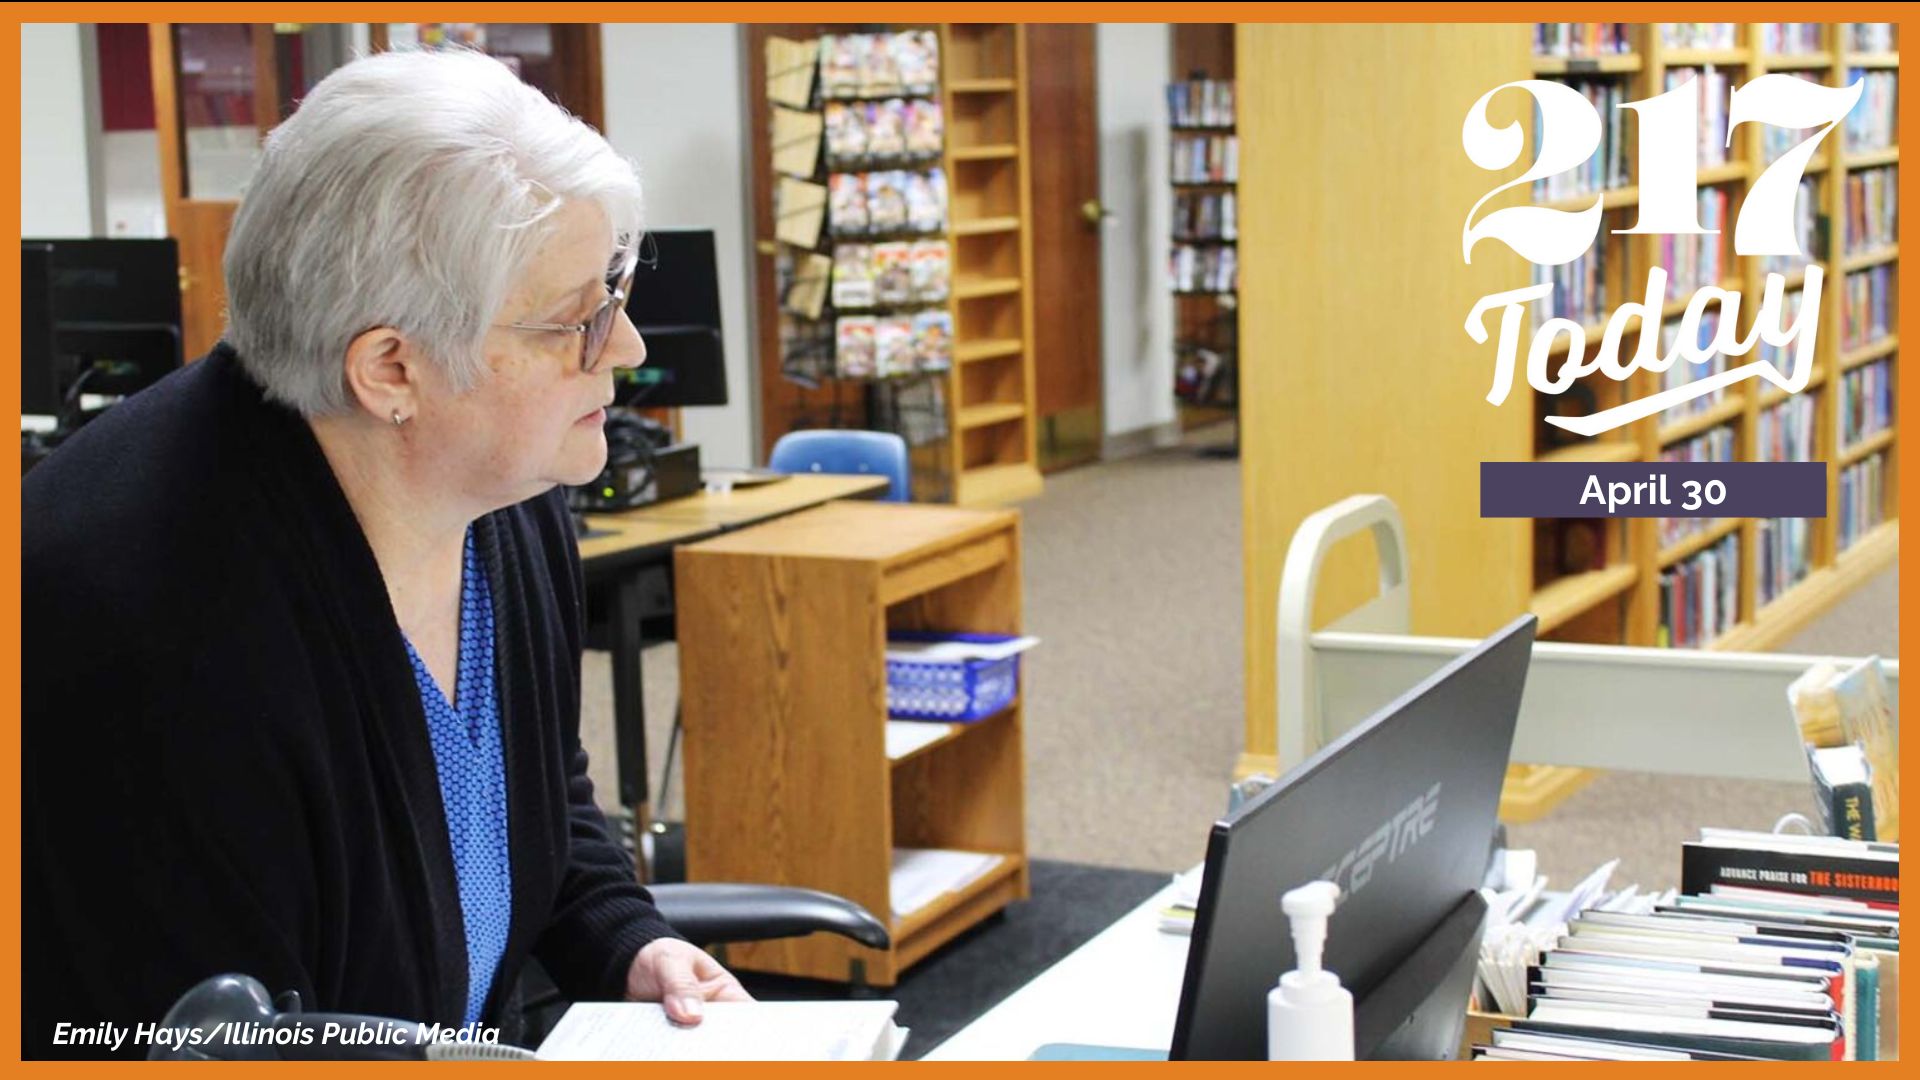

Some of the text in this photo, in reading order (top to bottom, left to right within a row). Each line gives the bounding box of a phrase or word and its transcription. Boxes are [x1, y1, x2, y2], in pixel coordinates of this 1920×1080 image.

[1320, 787, 1441, 907] CEPTRE
[1720, 867, 1757, 880] ADVANCE
[1759, 869, 1789, 883] PRAISE
[1791, 872, 1807, 885] FOR
[1810, 871, 1830, 887] THE
